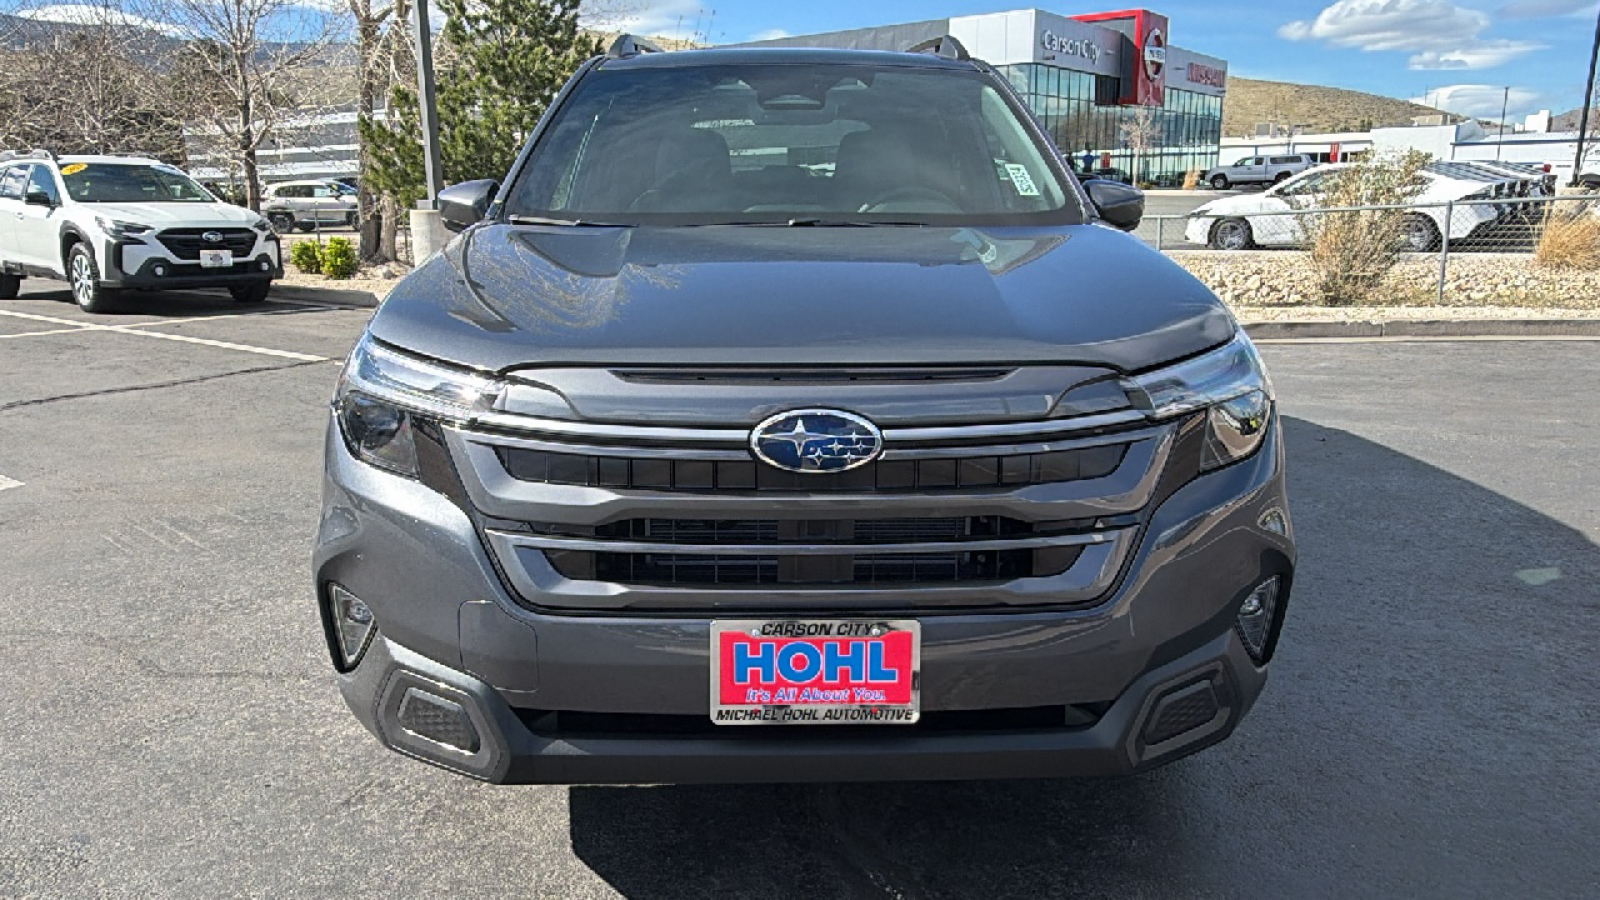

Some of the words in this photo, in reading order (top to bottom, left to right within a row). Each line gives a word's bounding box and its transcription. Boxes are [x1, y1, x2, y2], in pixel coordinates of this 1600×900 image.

[1043, 29, 1080, 56] Carson
[1083, 39, 1101, 65] City
[761, 623, 832, 636] CARSON
[837, 623, 875, 636] CITY
[734, 640, 898, 685] HOHL
[746, 687, 771, 702] It's
[773, 687, 798, 702] All
[799, 687, 850, 702] About
[853, 687, 886, 701] You.
[715, 709, 779, 721] MICHAEL
[782, 709, 820, 721] HOHL
[823, 708, 915, 721] AUTOMOTIVE
